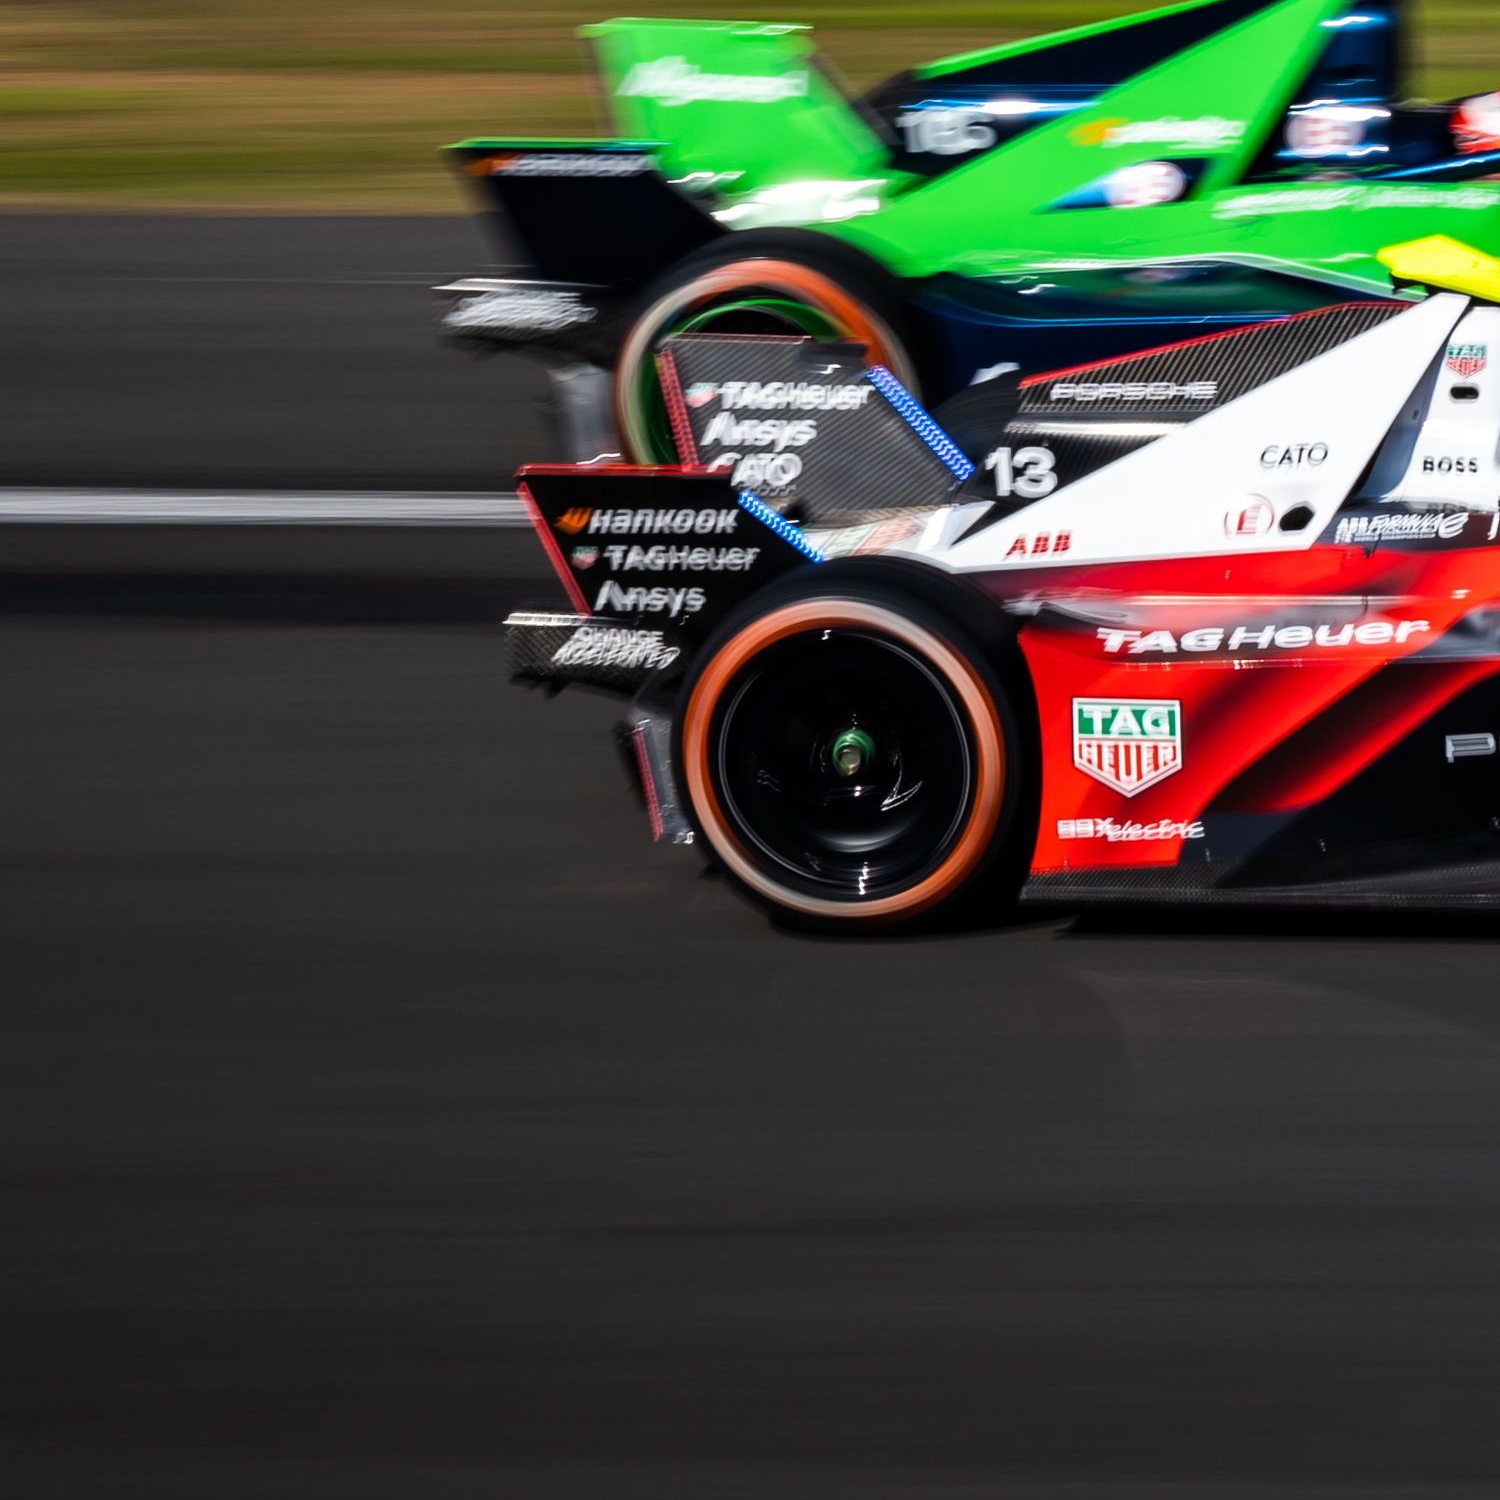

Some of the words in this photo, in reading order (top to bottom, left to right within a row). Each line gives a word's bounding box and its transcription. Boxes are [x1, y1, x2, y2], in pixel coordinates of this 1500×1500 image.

[1050, 381, 1218, 401] PORSCHE
[1259, 442, 1328, 469] CATO
[1422, 456, 1479, 474] BOSS
[985, 446, 1058, 498] 13
[1005, 531, 1073, 560] ABB
[594, 580, 707, 618] Ansys
[1081, 705, 1170, 738] TAG
[1079, 740, 1176, 784] HEUER
